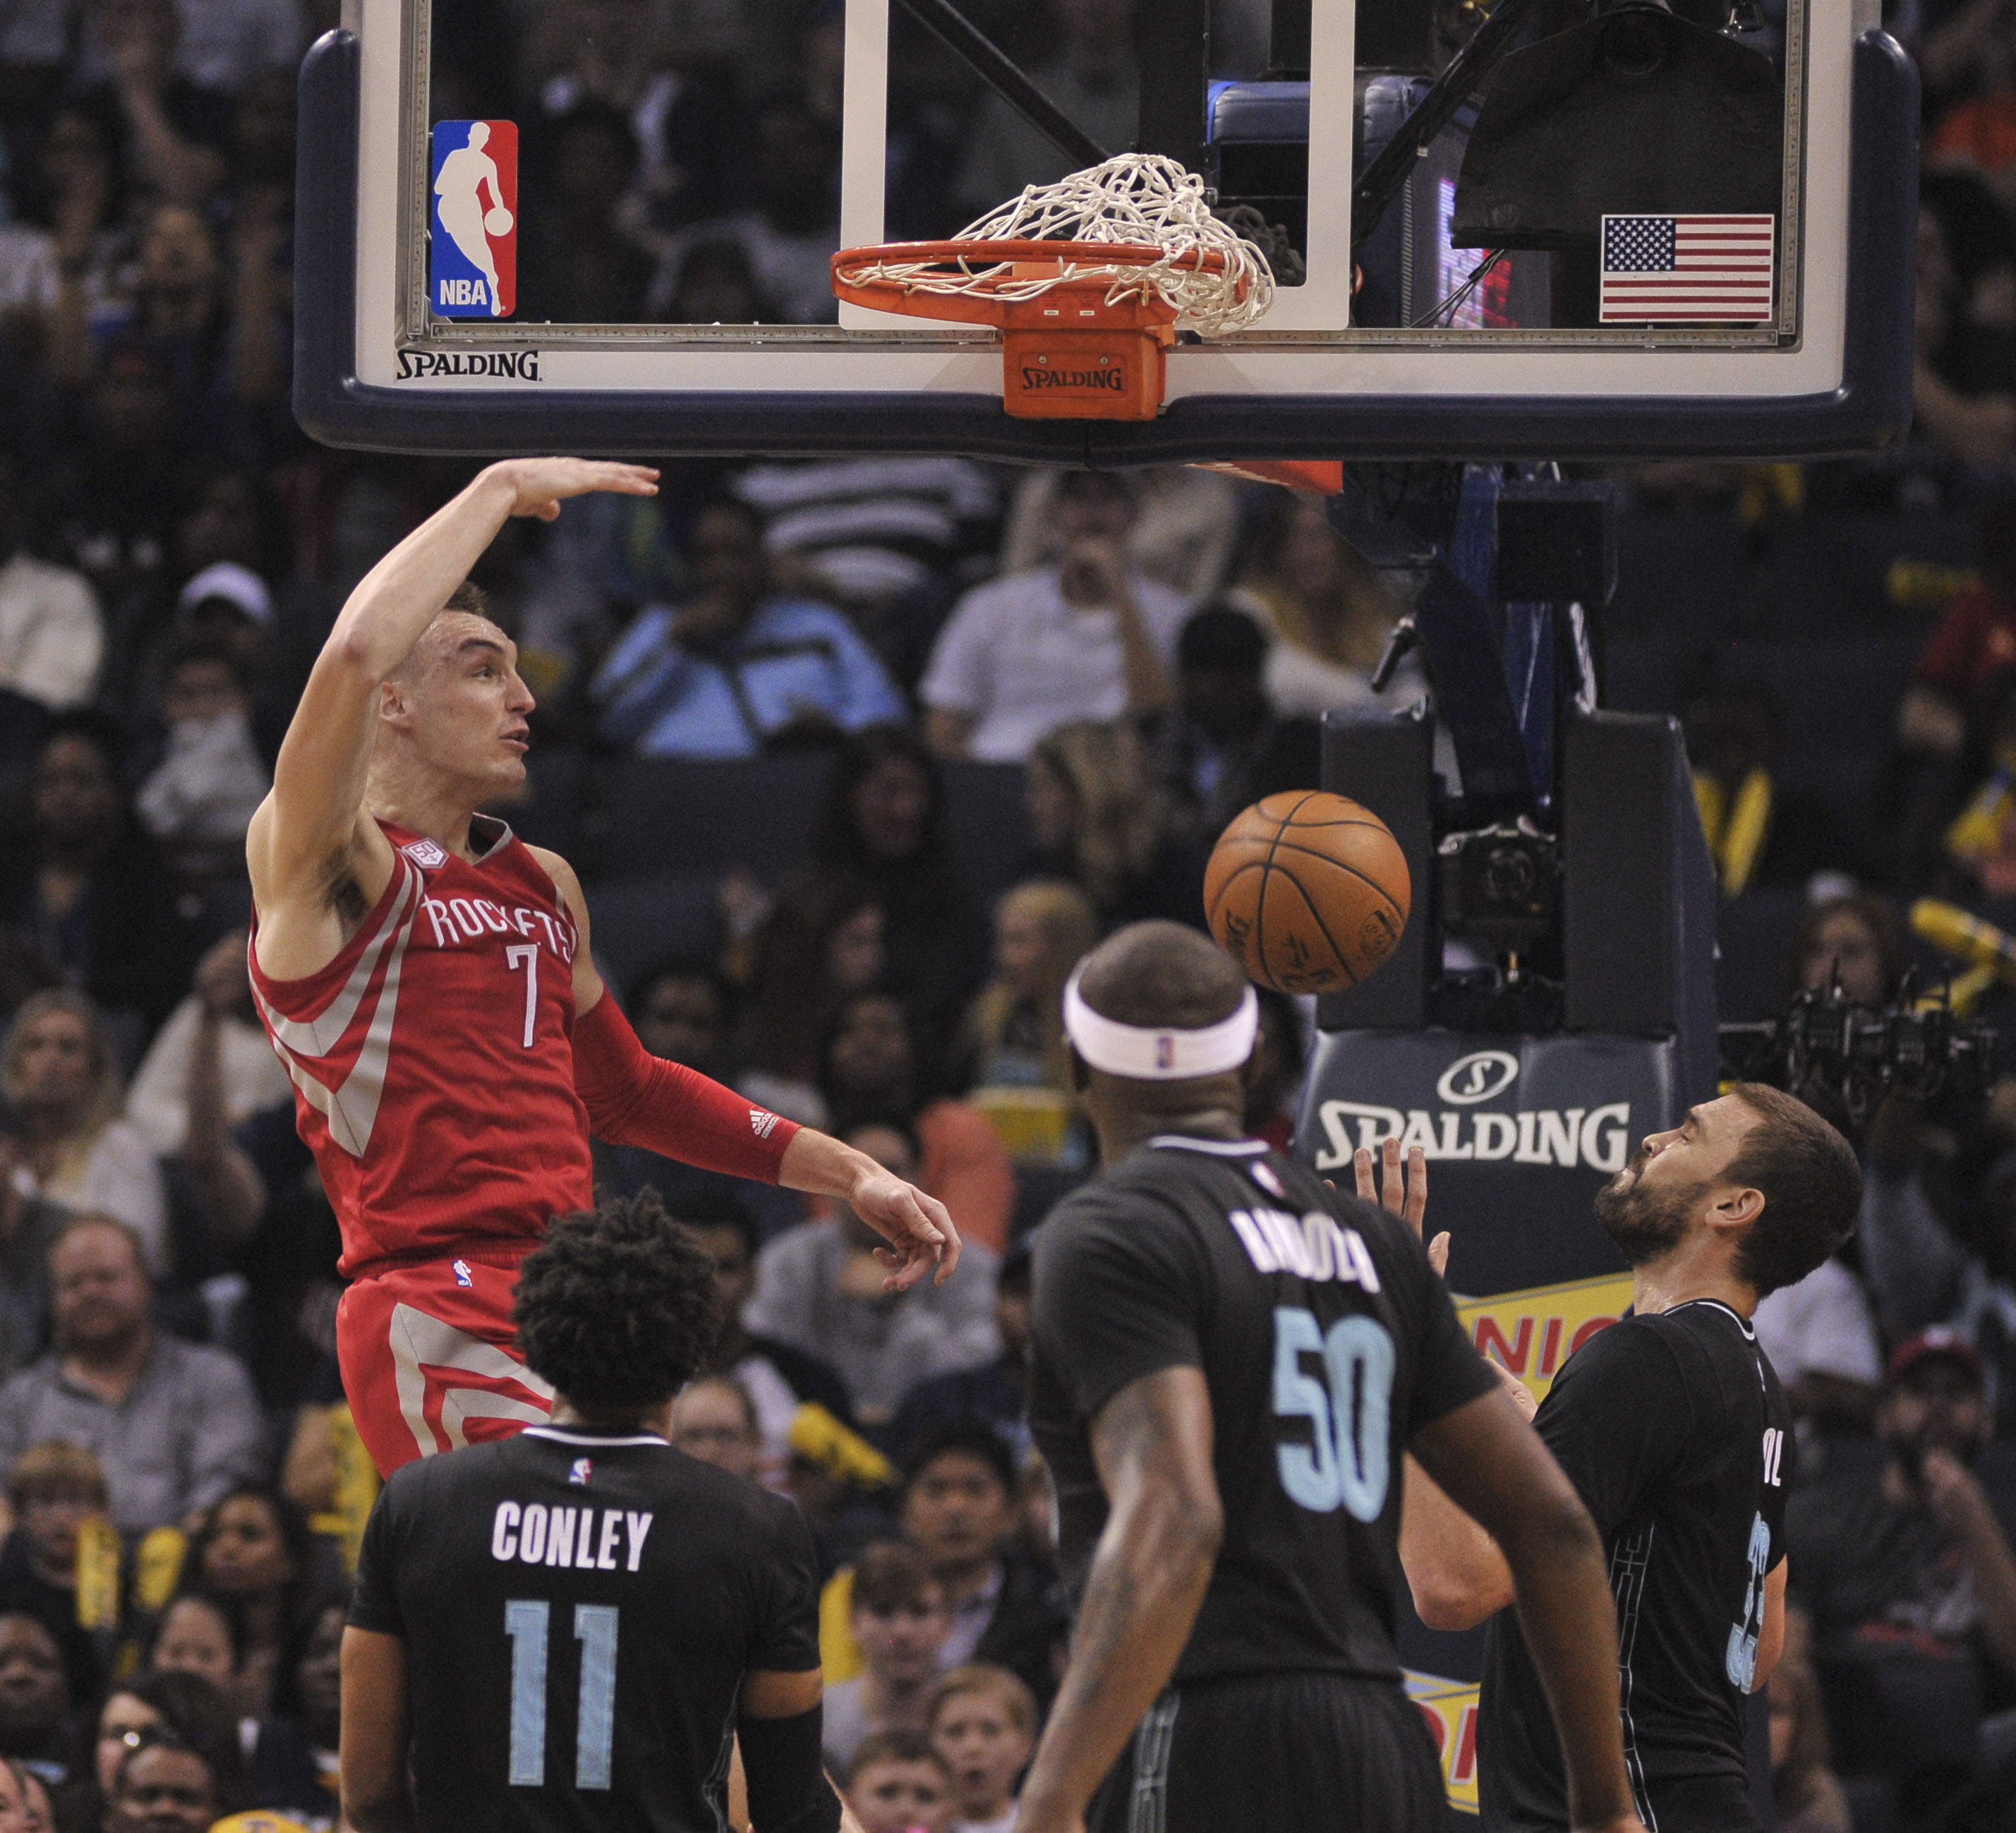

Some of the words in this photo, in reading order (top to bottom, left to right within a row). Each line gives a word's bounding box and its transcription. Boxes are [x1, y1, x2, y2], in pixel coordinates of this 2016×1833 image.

[440, 280, 487, 305] NBA
[397, 349, 539, 382] SPALDING
[1022, 367, 1123, 390] SPALDING
[411, 843, 437, 858] 50
[506, 944, 538, 1048] 7
[1315, 1100, 1630, 1174] SPALDING
[1273, 1307, 1396, 1524] 50
[492, 1501, 653, 1572] CONLEY
[505, 1599, 620, 1791] 11
